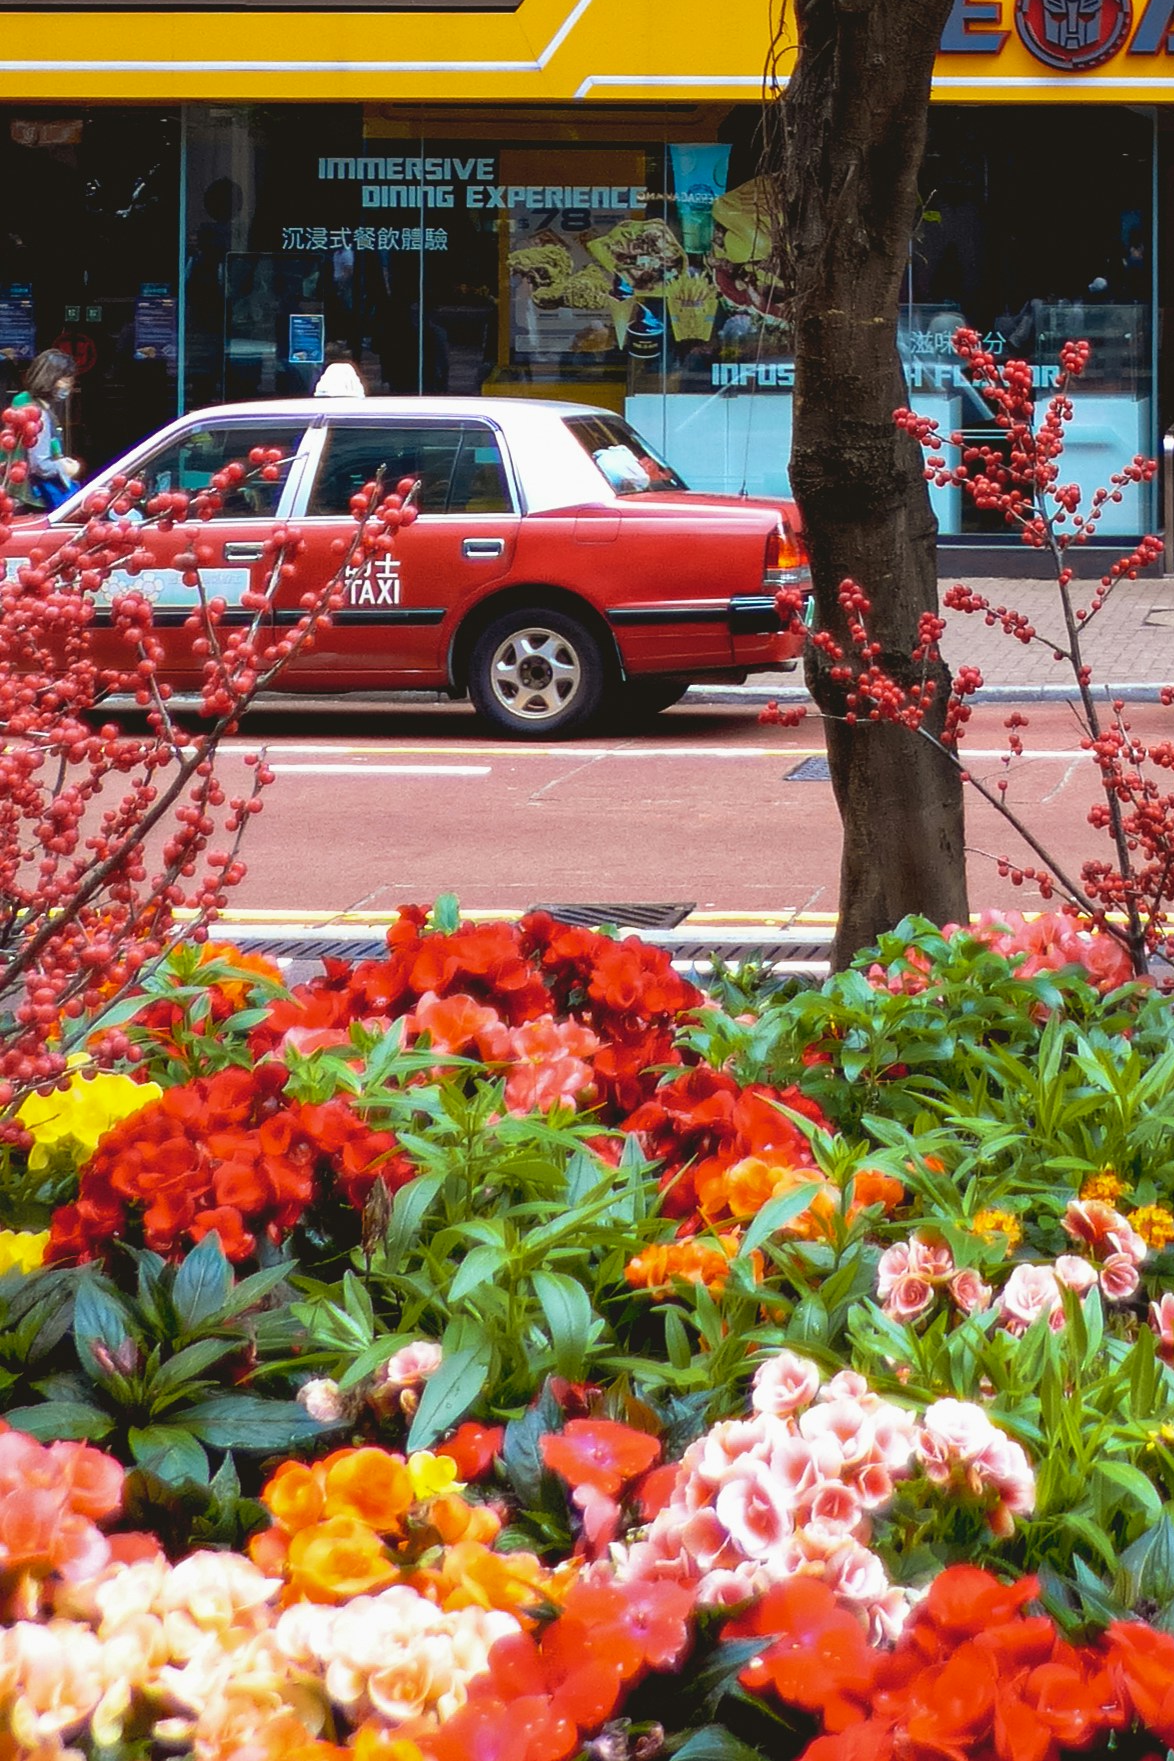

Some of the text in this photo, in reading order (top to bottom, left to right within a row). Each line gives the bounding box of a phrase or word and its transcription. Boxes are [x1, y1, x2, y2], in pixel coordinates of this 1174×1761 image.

[318, 157, 496, 180] IMMERSIVE
[361, 185, 648, 209] DINING EXPERIENCE
[281, 226, 450, 252] 沉浸式餐飲體驗
[909, 330, 1007, 355] 滋味分
[711, 362, 796, 387] INFUS
[344, 579, 401, 605] TAXI
